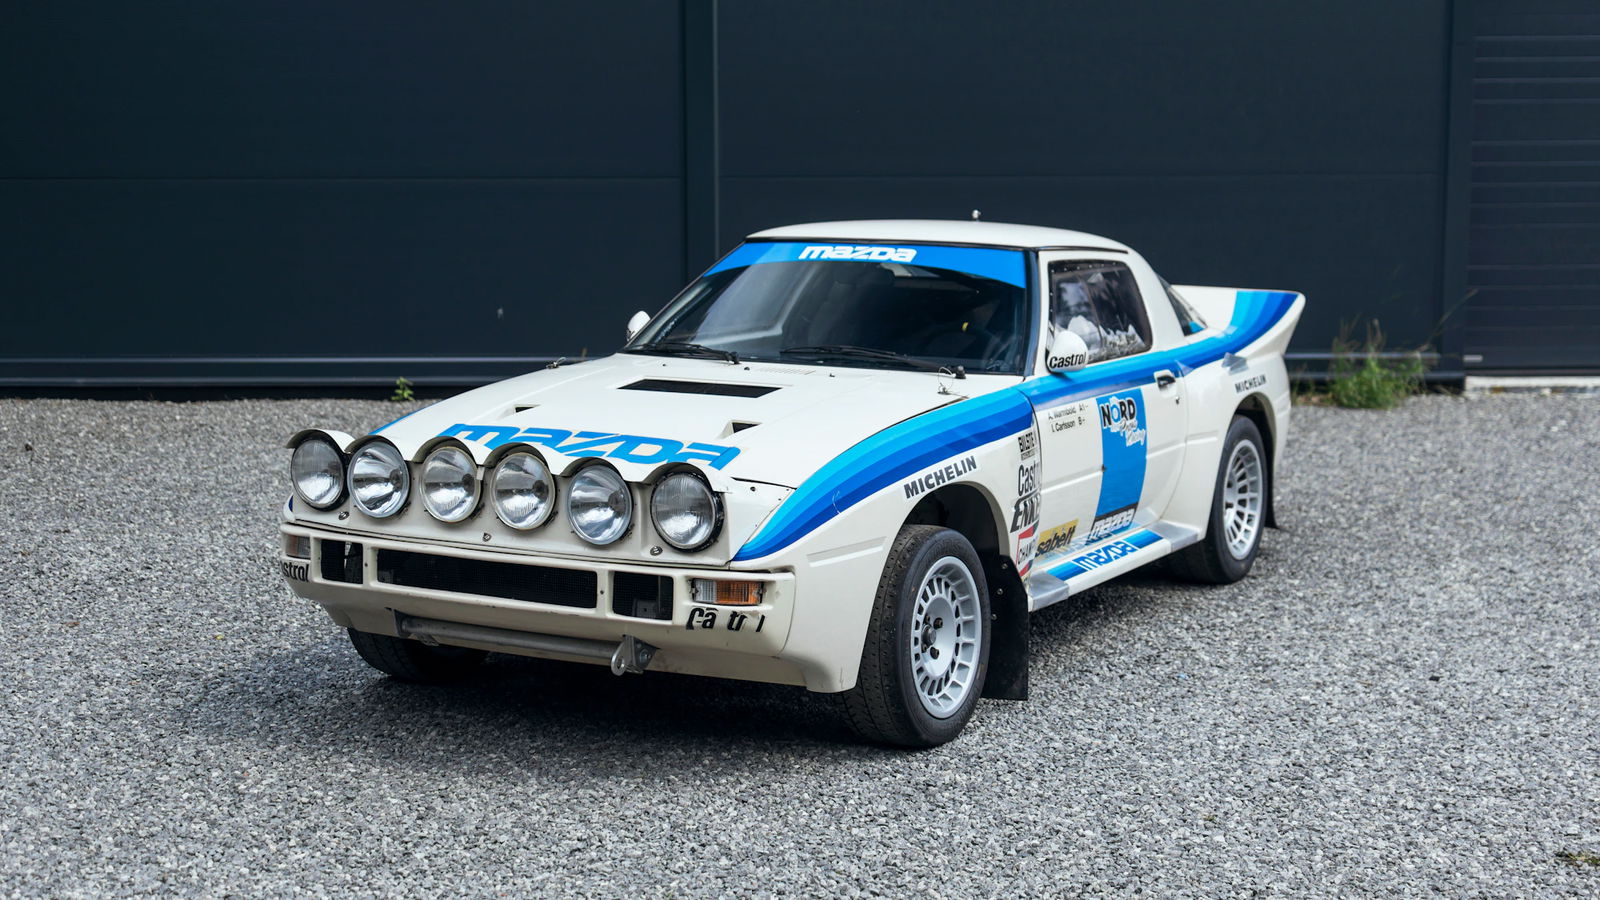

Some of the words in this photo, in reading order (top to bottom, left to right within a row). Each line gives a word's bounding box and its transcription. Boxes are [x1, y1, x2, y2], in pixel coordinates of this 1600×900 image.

[1049, 352, 1087, 369] Castrol
[1234, 374, 1267, 394] MICHELIN
[1100, 399, 1136, 428] NORD
[903, 455, 977, 499] MICHELIN
[1035, 525, 1077, 557] sabelt
